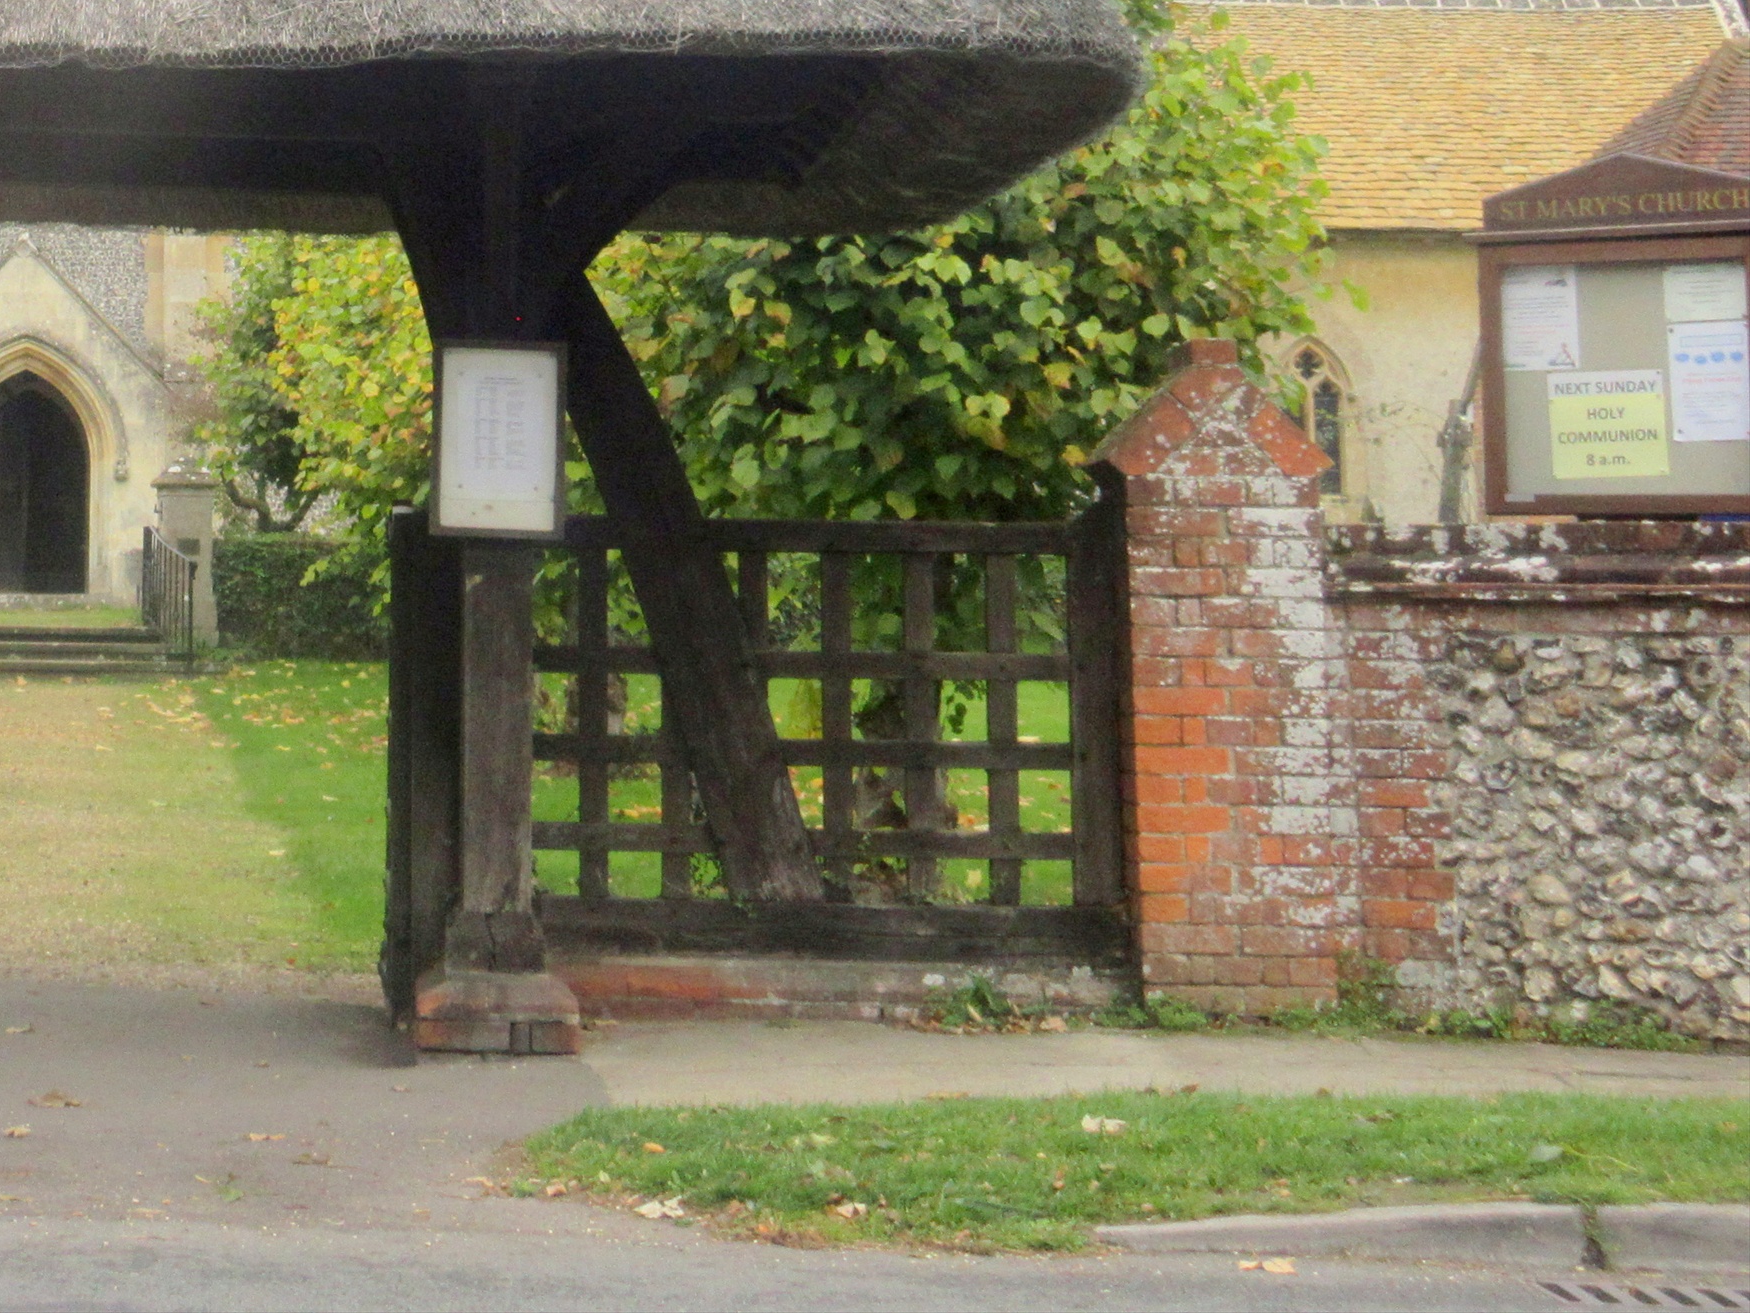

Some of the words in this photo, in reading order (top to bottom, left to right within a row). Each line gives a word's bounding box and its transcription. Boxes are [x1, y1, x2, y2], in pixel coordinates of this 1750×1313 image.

[1500, 201, 1529, 220] ST
[1537, 196, 1632, 218] MARY'S
[1639, 189, 1750, 213] CHURCH
[1554, 382, 1590, 395] NEXT
[1595, 380, 1656, 393] SUNDAY
[1587, 407, 1625, 420] HOLY
[1558, 429, 1658, 444] COMMUNION
[1586, 454, 1595, 466] 8
[1599, 455, 1631, 465] a.m.
